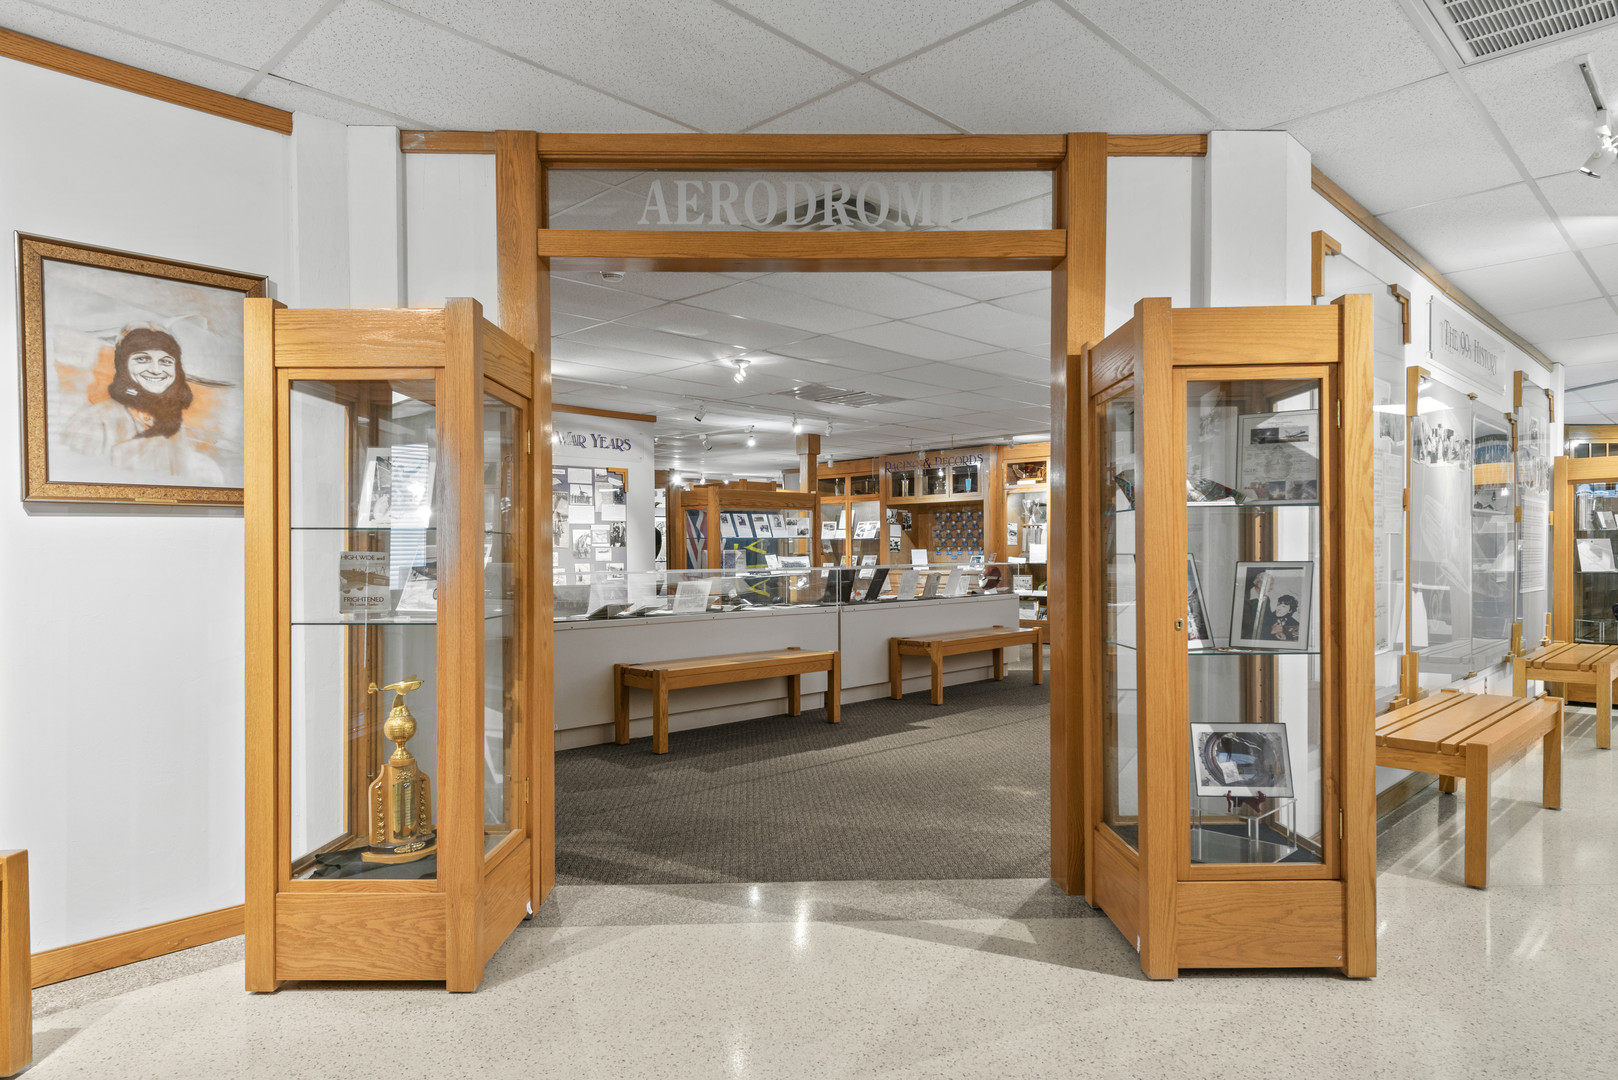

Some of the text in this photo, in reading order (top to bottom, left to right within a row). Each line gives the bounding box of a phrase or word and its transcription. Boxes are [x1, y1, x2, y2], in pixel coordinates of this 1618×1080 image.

[636, 178, 968, 227] AERODROME
[555, 430, 631, 452] WAR YEARS
[923, 457, 932, 469] &
[935, 453, 984, 467] RECORDS
